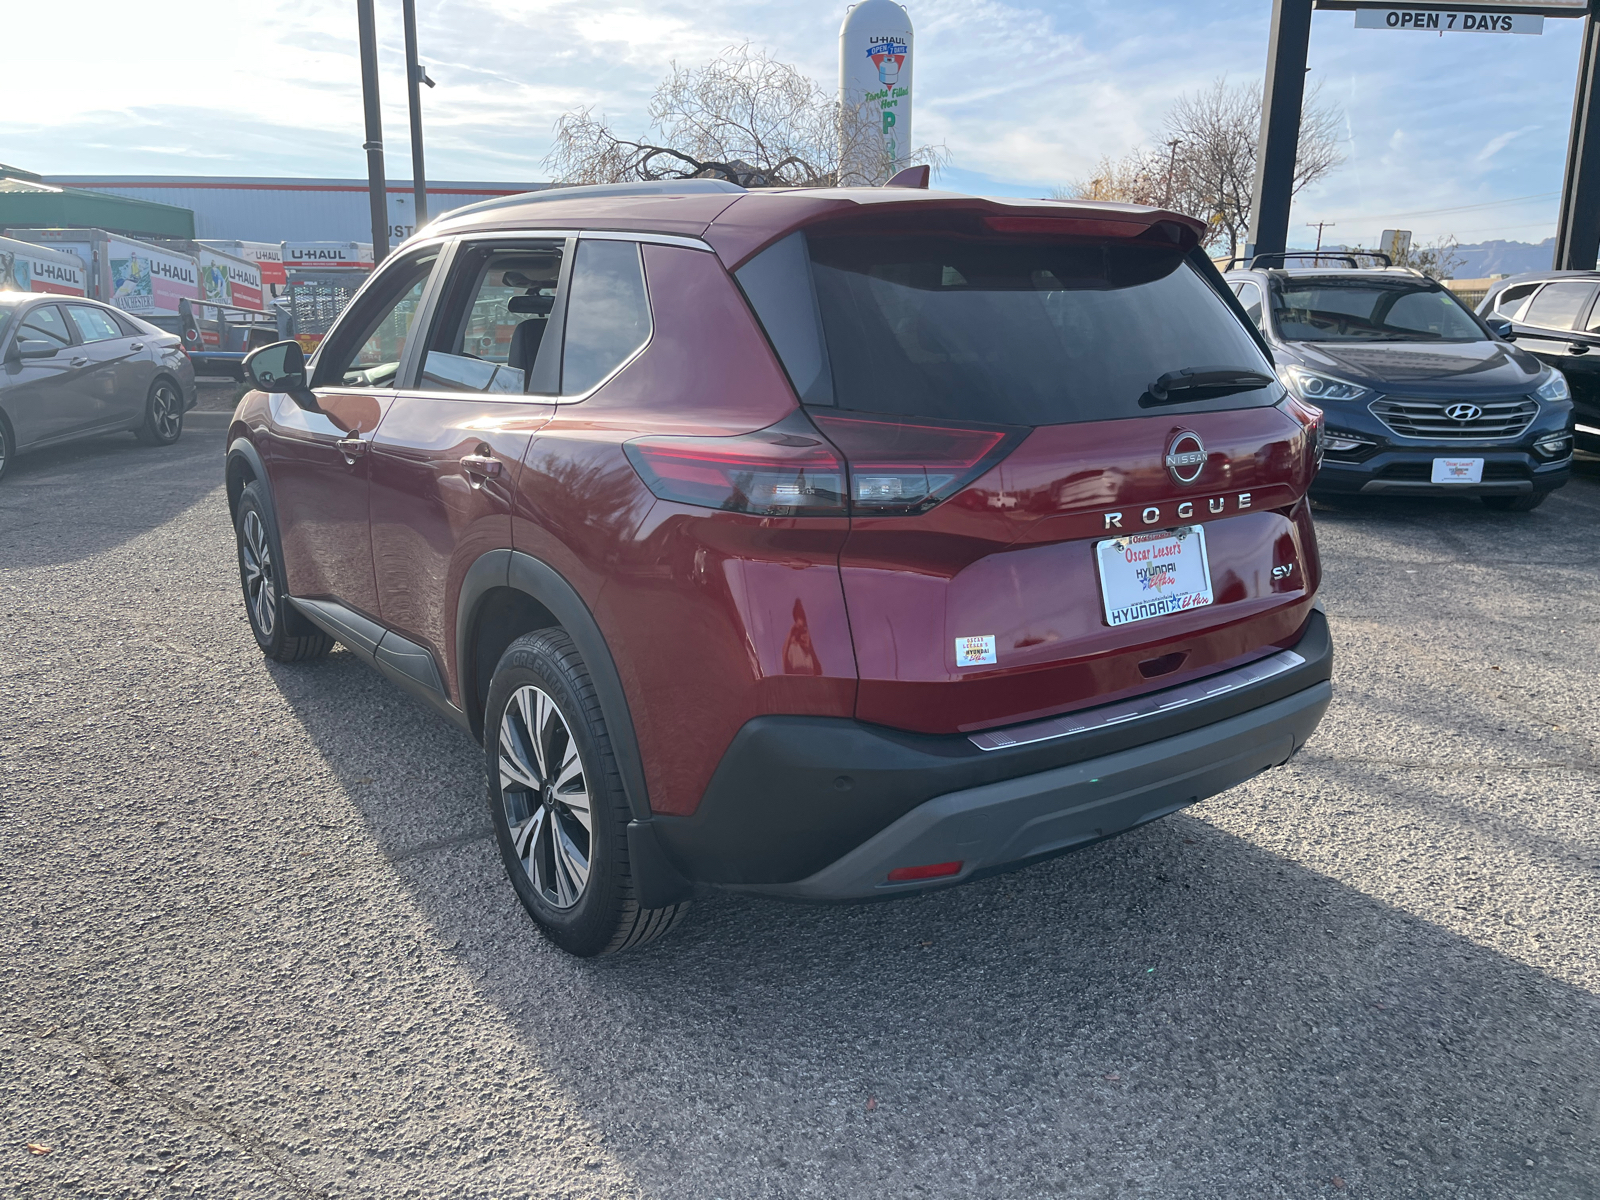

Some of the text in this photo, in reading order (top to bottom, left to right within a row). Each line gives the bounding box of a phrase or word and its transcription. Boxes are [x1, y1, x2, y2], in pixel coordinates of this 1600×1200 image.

[1386, 11, 1512, 31] OPEN 7 DAYS
[870, 36, 906, 45] U-HAUL
[871, 45, 888, 54] OPEN
[865, 86, 909, 102] Tanks Filled
[881, 99, 898, 109] Here
[255, 250, 281, 261] U-HAUL
[291, 250, 346, 260] U-HAUL
[33, 261, 79, 284] U-HAUL
[150, 260, 195, 284] U-HAUL
[228, 266, 260, 288] U-HAUL
[1166, 451, 1208, 466] NISSAN
[1104, 493, 1252, 529] ROGUE
[1125, 541, 1182, 563] Oscar Leeser's
[1136, 562, 1177, 579] HYUNDAI
[1271, 562, 1293, 581] SV
[1112, 600, 1170, 624] HYUNDAI
